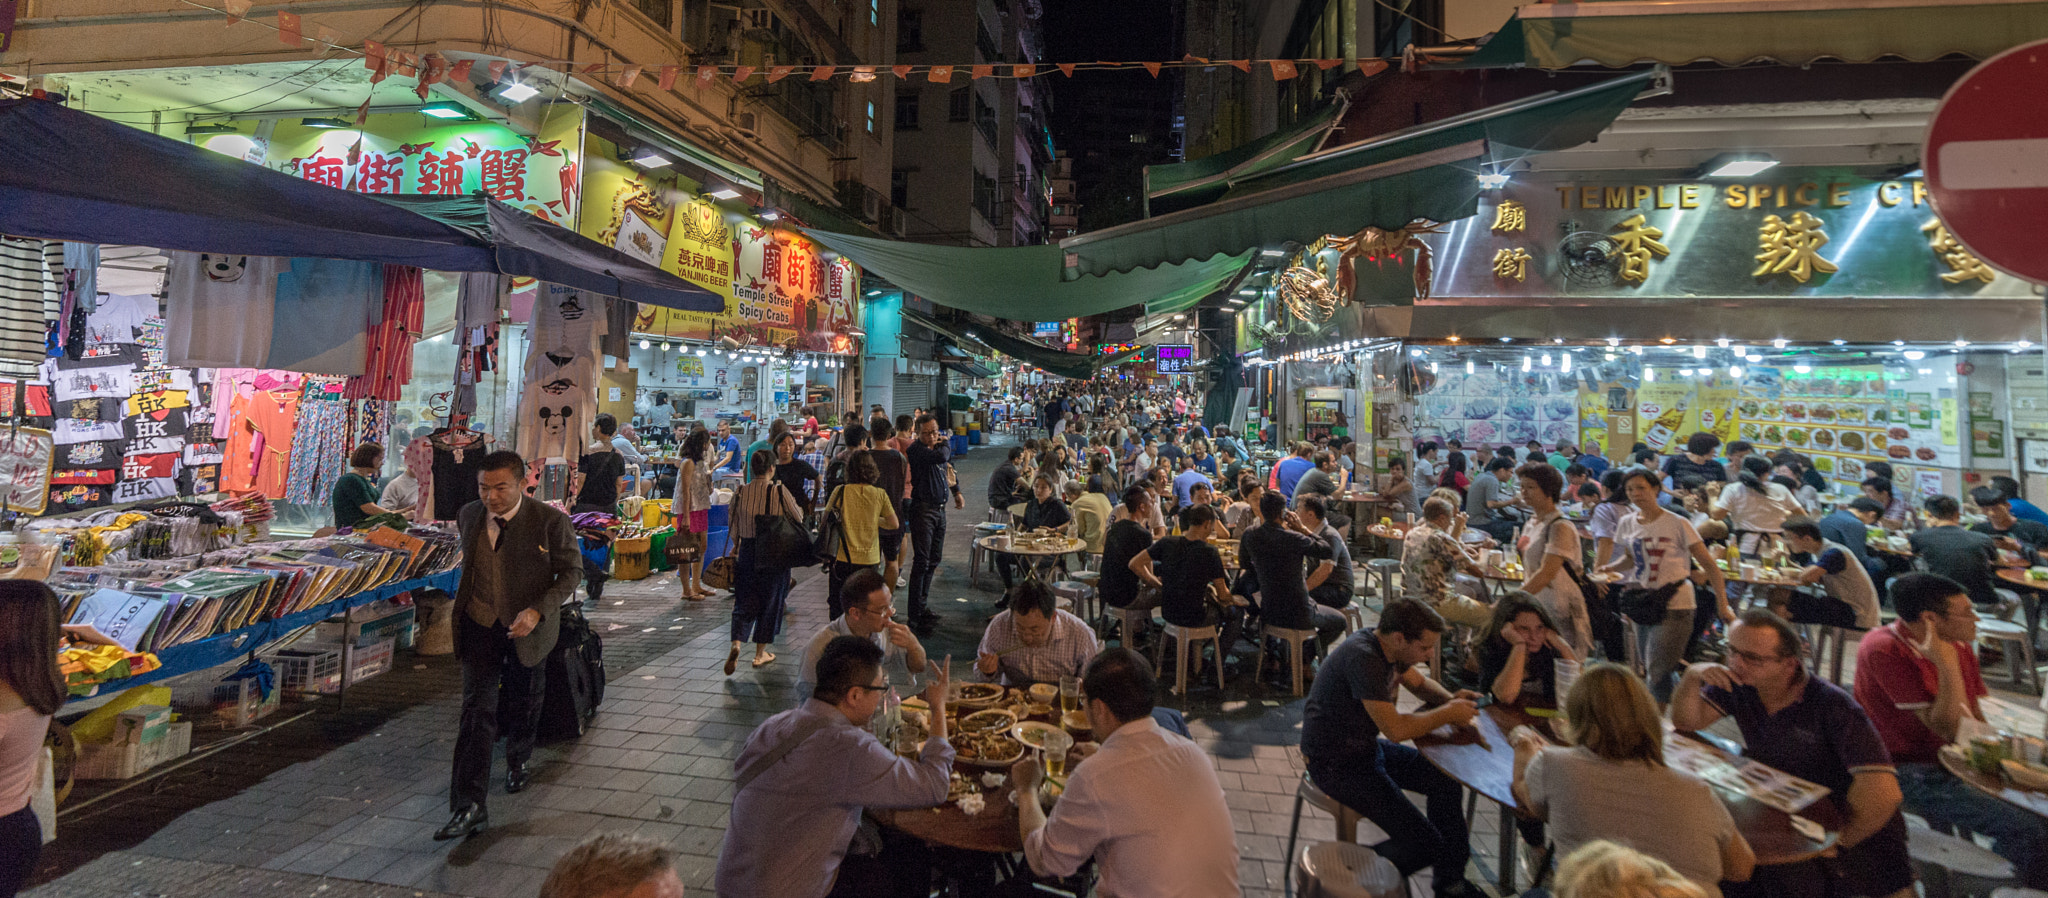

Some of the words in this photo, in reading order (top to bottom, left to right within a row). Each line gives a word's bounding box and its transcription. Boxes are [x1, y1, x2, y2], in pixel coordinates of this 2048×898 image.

[302, 149, 528, 201] 廟街辣蟹
[1556, 185, 1701, 209] TEMPLE
[1727, 182, 1852, 209] SPICE
[1490, 199, 1532, 284] 廟街
[678, 248, 729, 277] 燕京啤酒
[761, 240, 844, 300] 廟街辣蟹
[677, 267, 709, 283] YANJING
[709, 275, 728, 288] BEER
[732, 283, 766, 303] Temple
[768, 292, 793, 308] Street
[673, 312, 687, 320] REAL
[688, 314, 703, 323] TASTE
[739, 302, 764, 321] Spicy
[766, 311, 789, 323] Crabs
[138, 398, 166, 413] HK
[135, 421, 168, 438] HK
[123, 466, 152, 479] HK
[120, 480, 153, 498] HK
[669, 547, 695, 555] MANGO
